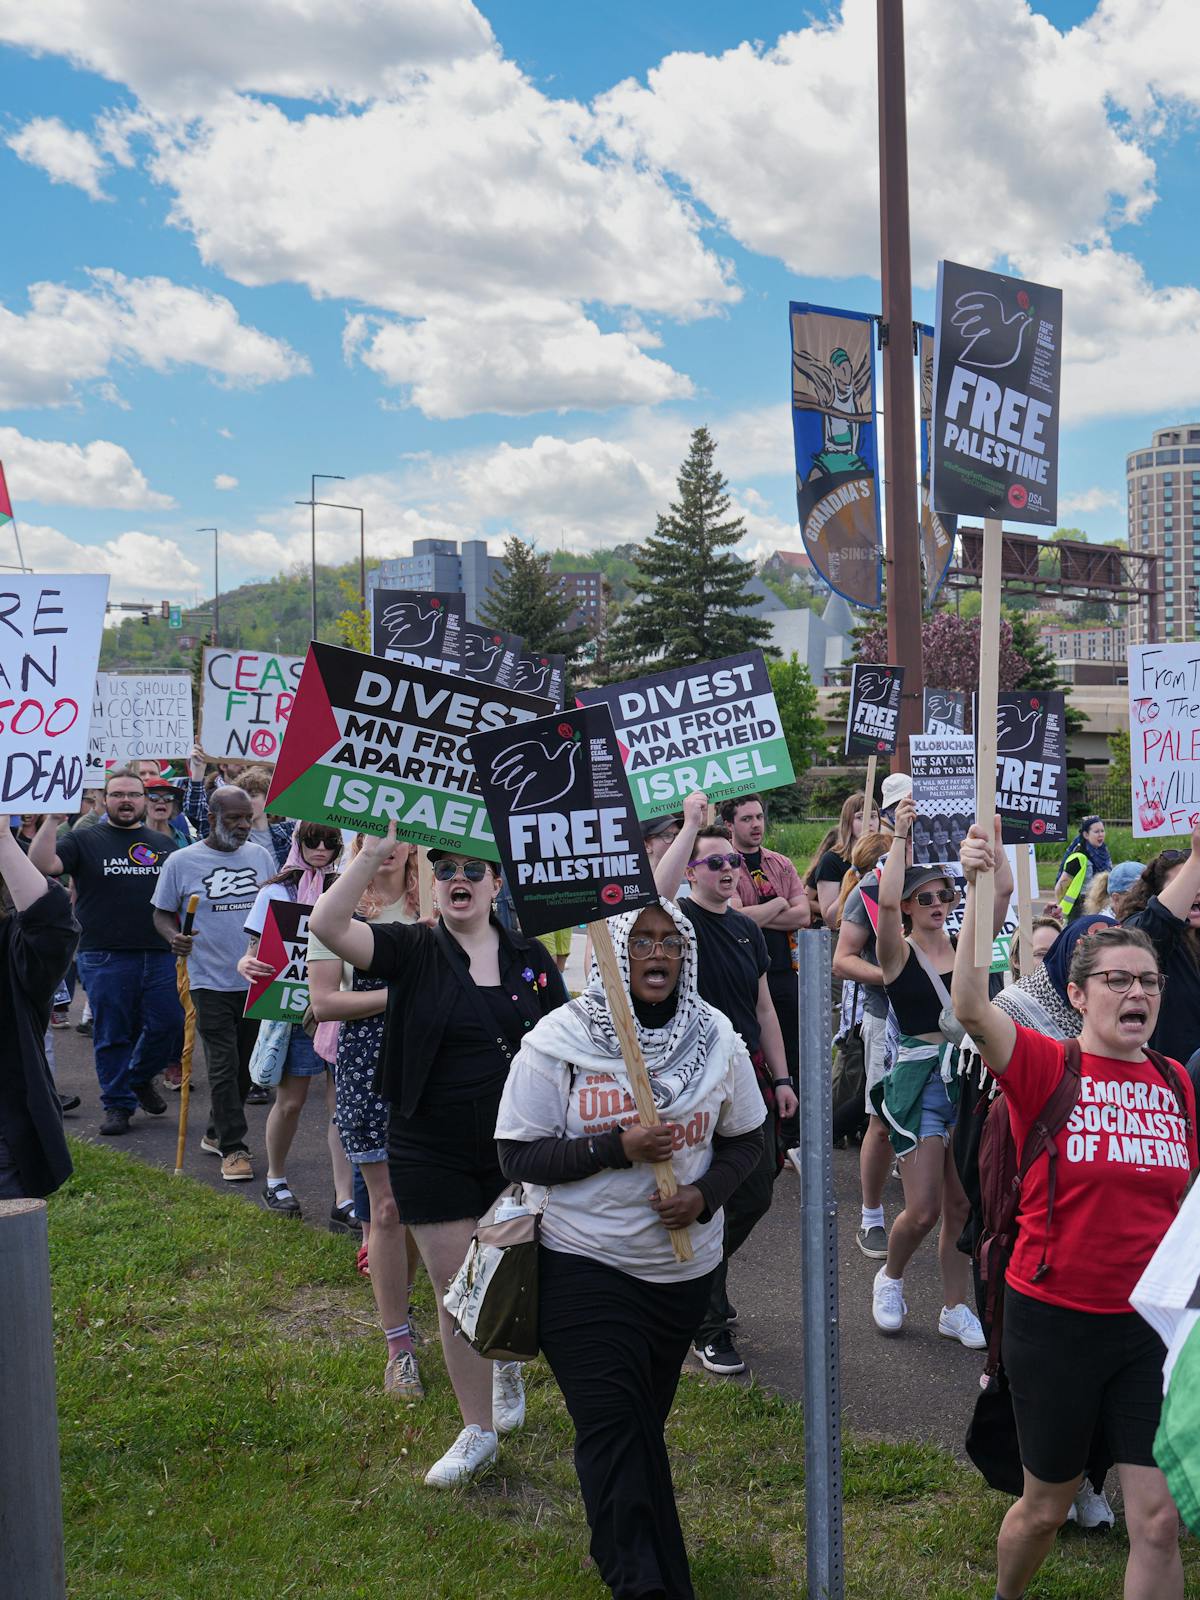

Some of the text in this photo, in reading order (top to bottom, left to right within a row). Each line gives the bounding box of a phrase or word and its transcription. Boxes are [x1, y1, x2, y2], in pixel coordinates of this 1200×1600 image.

[945, 365, 1052, 454] FREE
[944, 422, 1050, 485] PALESTINE
[805, 480, 870, 541] GRANDMA'S
[1028, 492, 1042, 505] DSA
[208, 652, 305, 692] CEAS
[1142, 650, 1185, 691] From
[136, 681, 187, 696] SHOULD
[619, 664, 755, 720] DIVEST
[108, 698, 187, 718] COGNIZE
[226, 690, 296, 724] FIR
[855, 701, 898, 730] FREE
[1133, 697, 1160, 723] To
[1166, 697, 1200, 718] The
[106, 718, 188, 738] LESTINE
[626, 700, 756, 748] MN FROM
[853, 722, 896, 741] PALESTINE
[111, 741, 189, 757] A COUNTRY
[226, 729, 284, 757] NO
[343, 714, 474, 765] MN FRO
[631, 719, 776, 770] APARTHEID
[914, 740, 974, 751] KLOBUCHAR
[2, 750, 83, 802] DEAD
[331, 743, 482, 795] APARTHE
[912, 756, 927, 766] WE
[930, 756, 948, 766] SAY
[949, 756, 964, 766] NO
[929, 766, 941, 775] AID
[943, 766, 954, 775] TO
[955, 766, 974, 775] ISRAE
[637, 750, 777, 804] ISRAEL
[323, 774, 495, 842] ISRAEL
[996, 791, 1061, 817] ALESTINE
[509, 807, 630, 860] FREE
[1046, 822, 1057, 831] DSA
[110, 858, 128, 866] AM
[517, 854, 640, 885] PALESTINE
[203, 868, 259, 899] BE
[623, 885, 640, 894] DSA
[1067, 1134, 1100, 1162] OF
